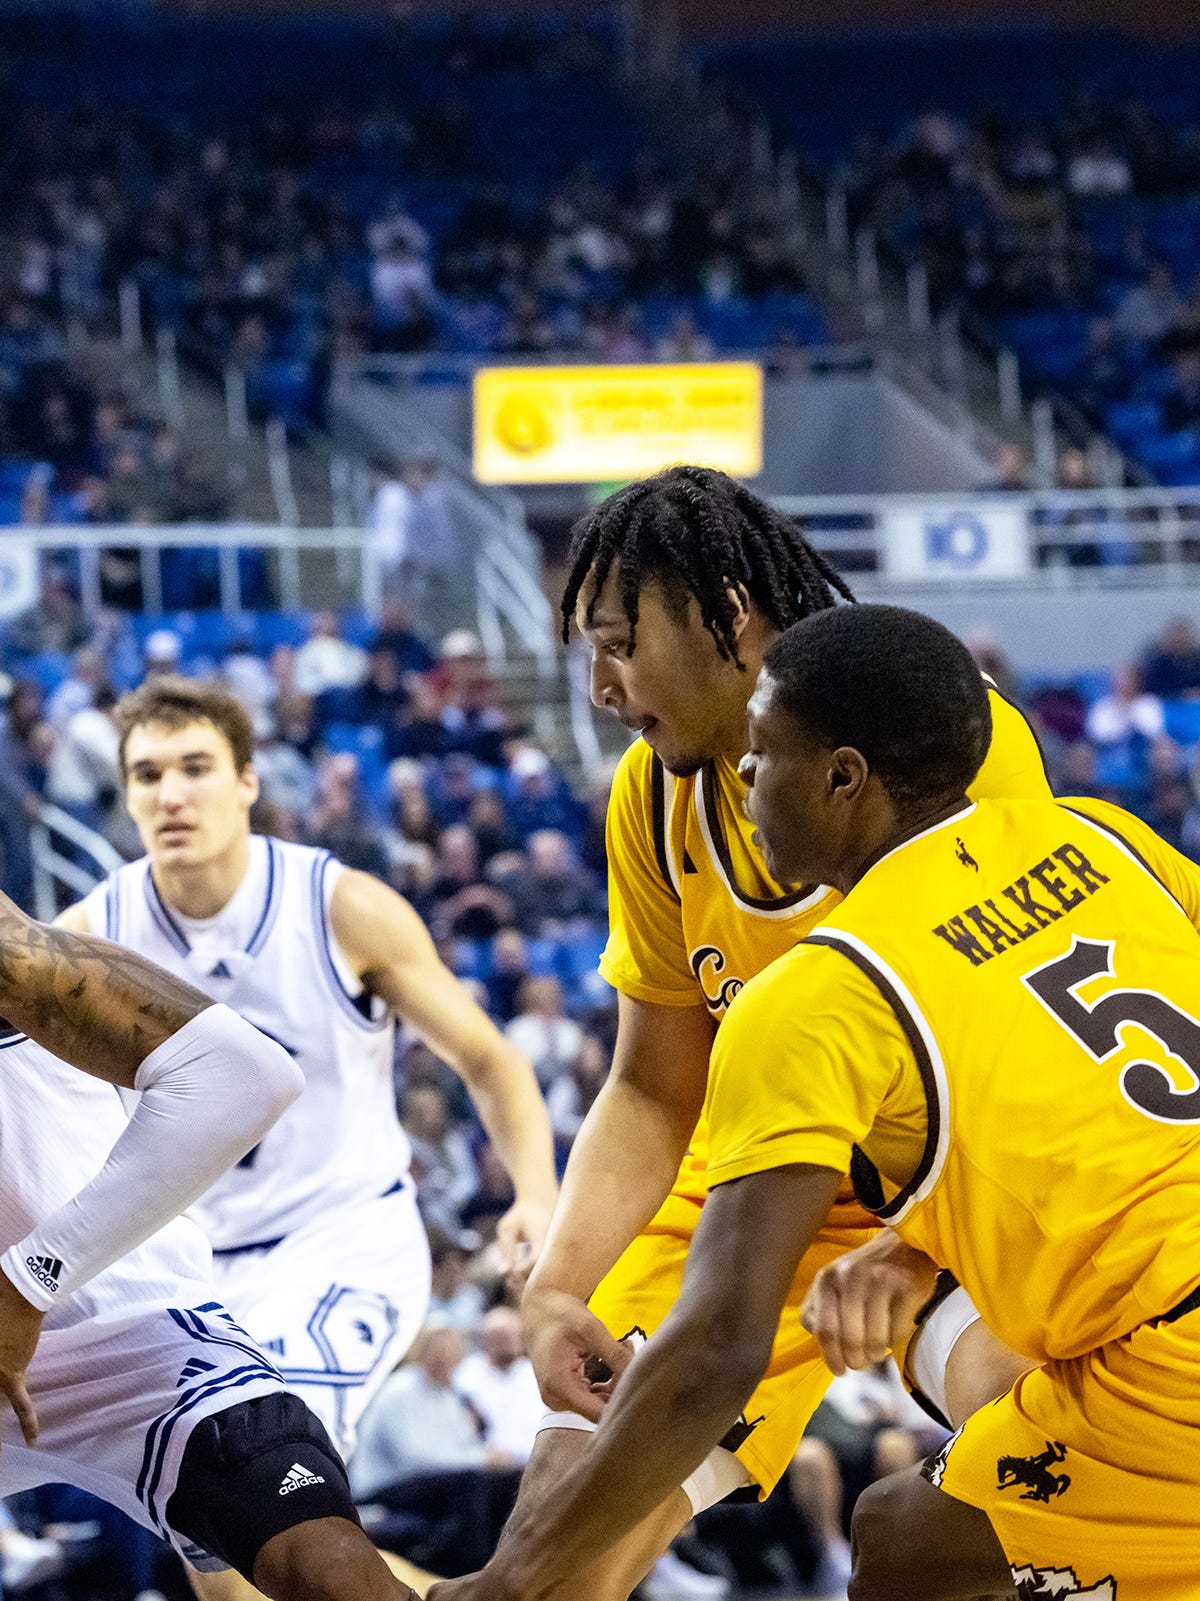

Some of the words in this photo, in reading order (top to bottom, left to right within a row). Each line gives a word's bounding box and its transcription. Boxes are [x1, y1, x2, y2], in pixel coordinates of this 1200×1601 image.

[932, 843, 1111, 967] WALKER
[1018, 933, 1200, 1125] 5
[26, 1256, 59, 1292] adidas
[279, 1476, 325, 1495] adidas
